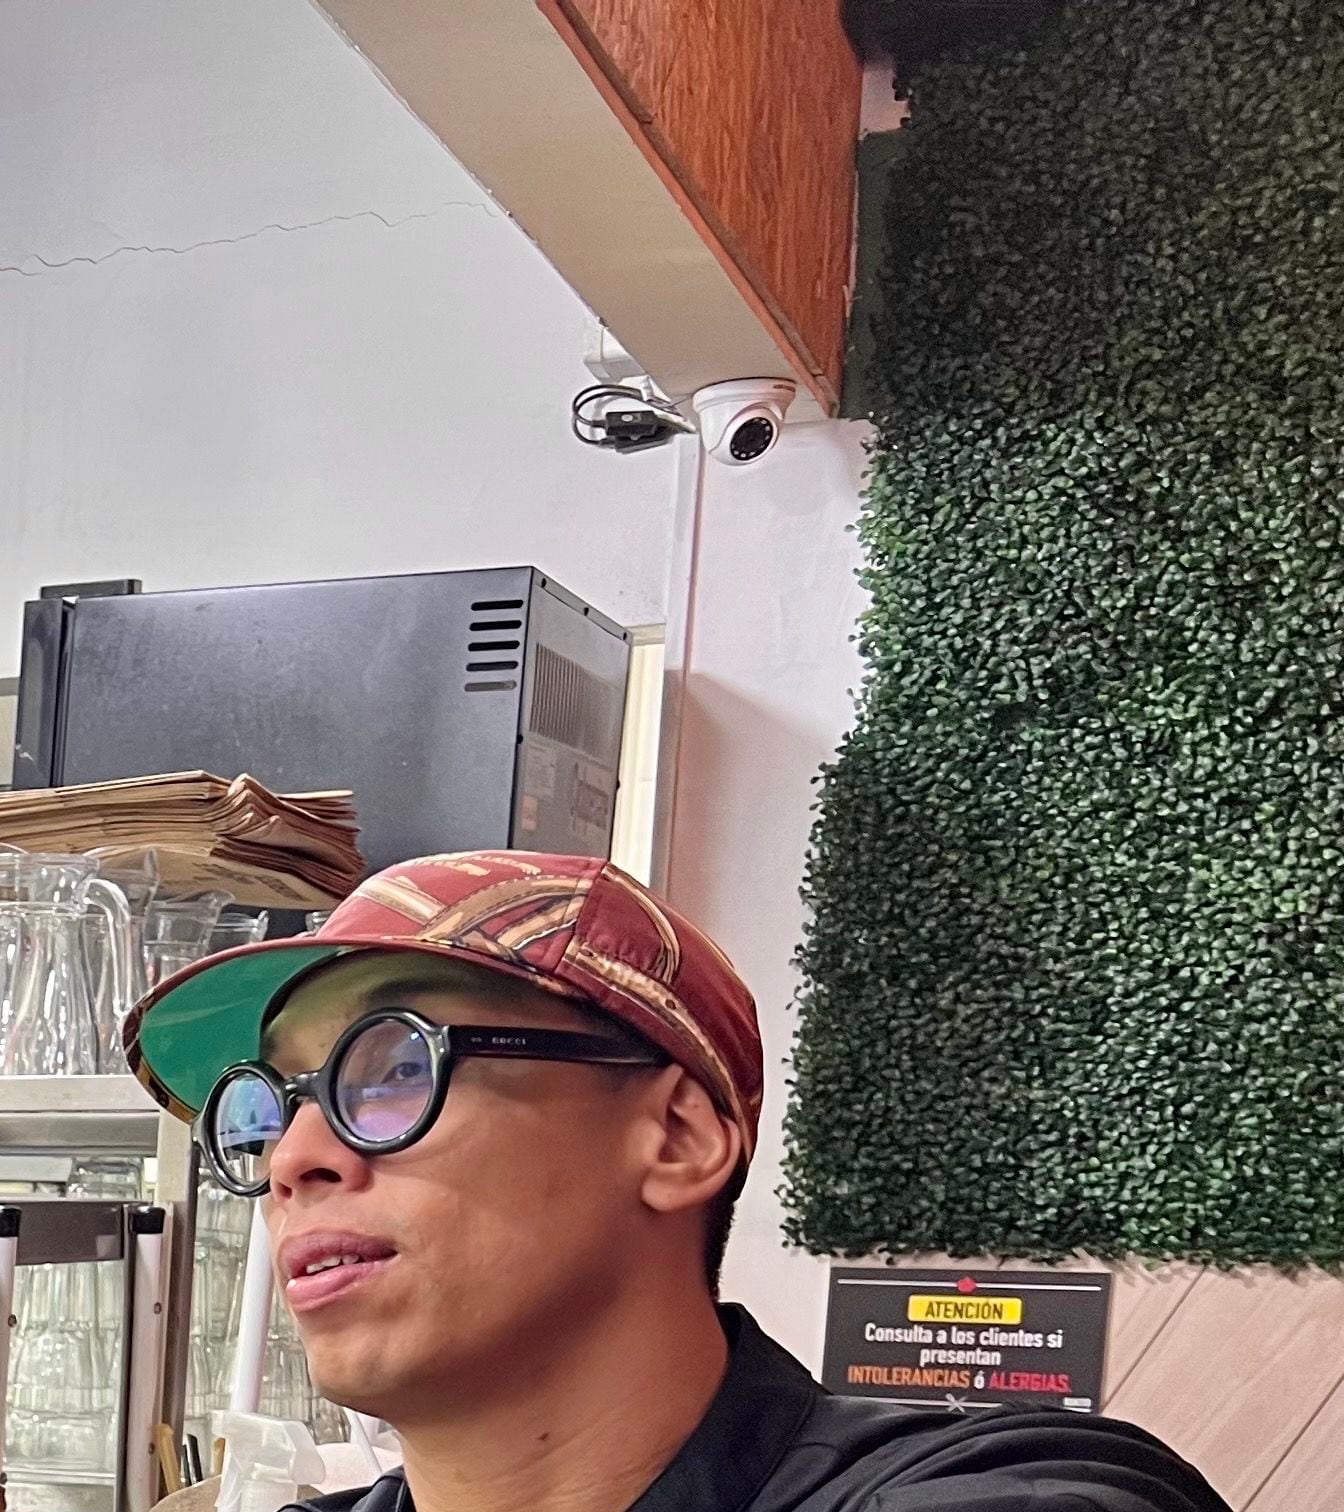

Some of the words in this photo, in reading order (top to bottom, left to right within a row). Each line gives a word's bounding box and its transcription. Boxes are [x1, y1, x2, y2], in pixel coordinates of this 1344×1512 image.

[864, 1322, 933, 1344] Consulta
[935, 1328, 948, 1344] a
[951, 1325, 976, 1346] los
[979, 1327, 1044, 1348] clientes
[1046, 1328, 1064, 1348] si
[919, 1348, 1002, 1367] presentan
[847, 1364, 971, 1388] INTOLERANCIAS
